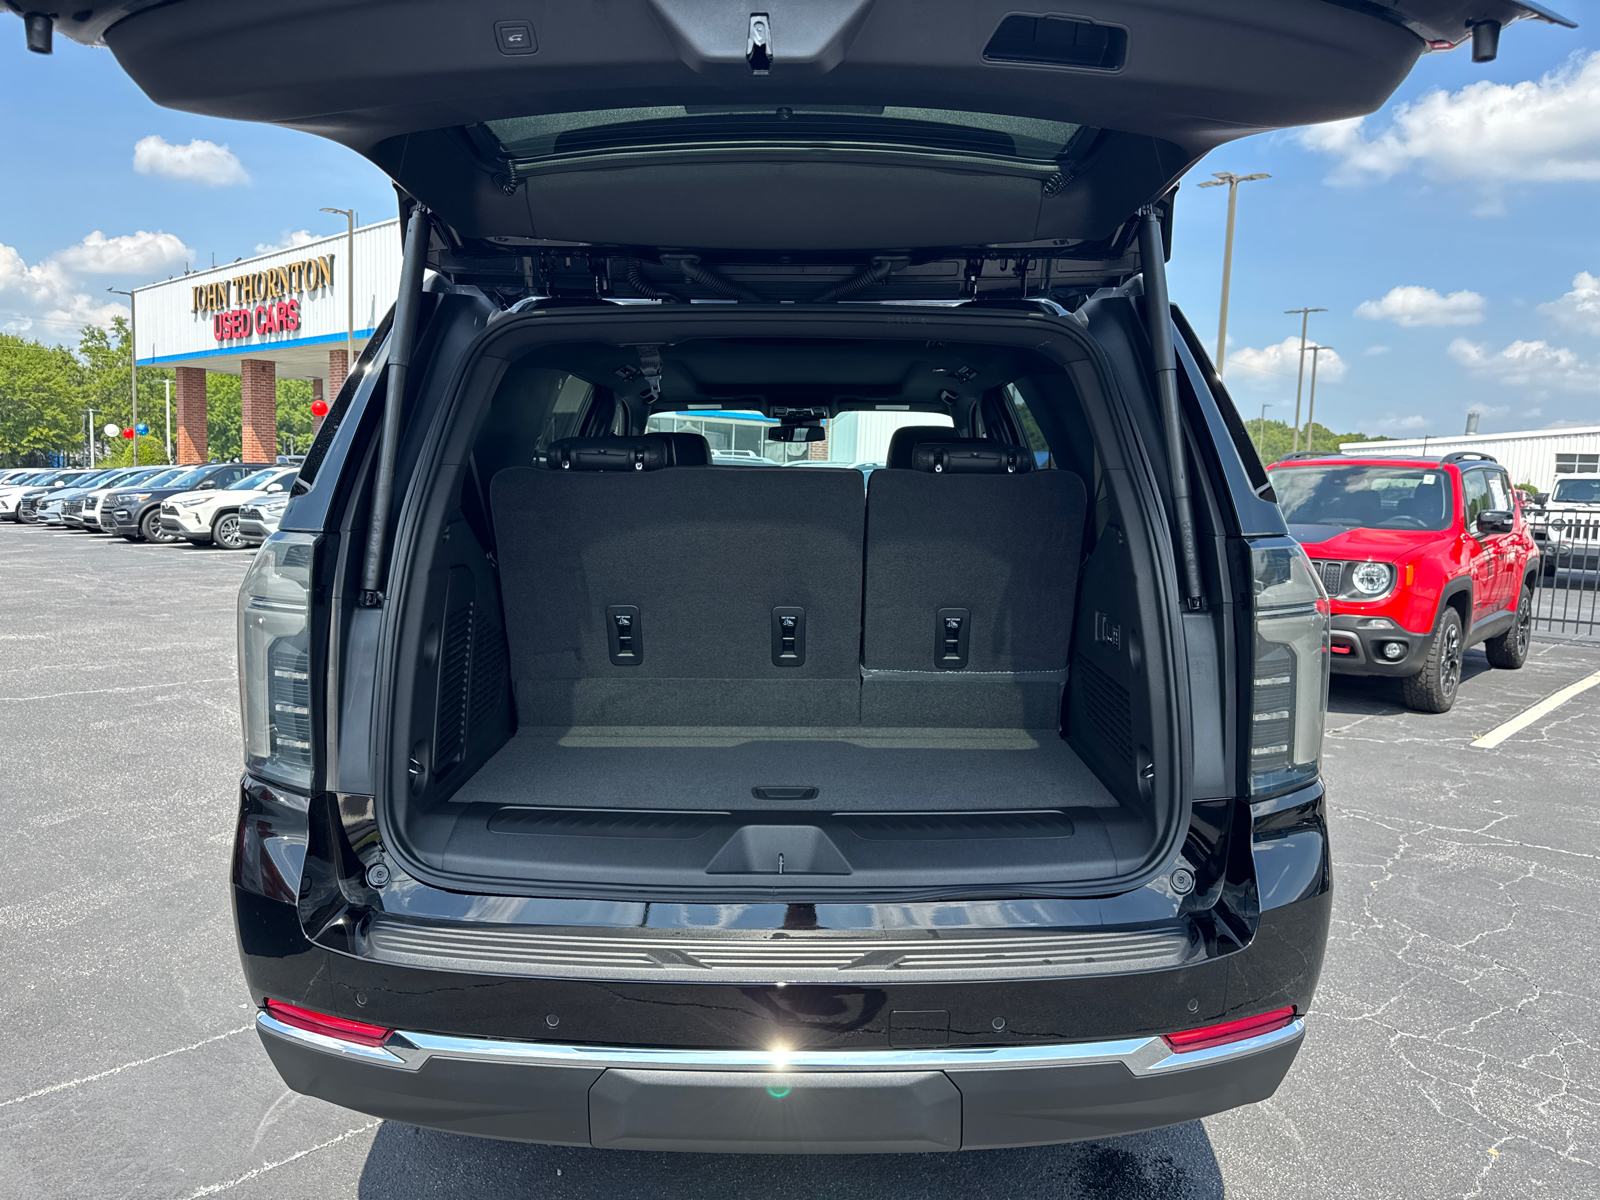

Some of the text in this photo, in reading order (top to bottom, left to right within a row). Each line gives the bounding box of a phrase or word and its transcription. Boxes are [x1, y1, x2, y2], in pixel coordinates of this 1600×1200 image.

[191, 254, 335, 313] JOHN THORNTON
[213, 299, 300, 341] USED CARS
